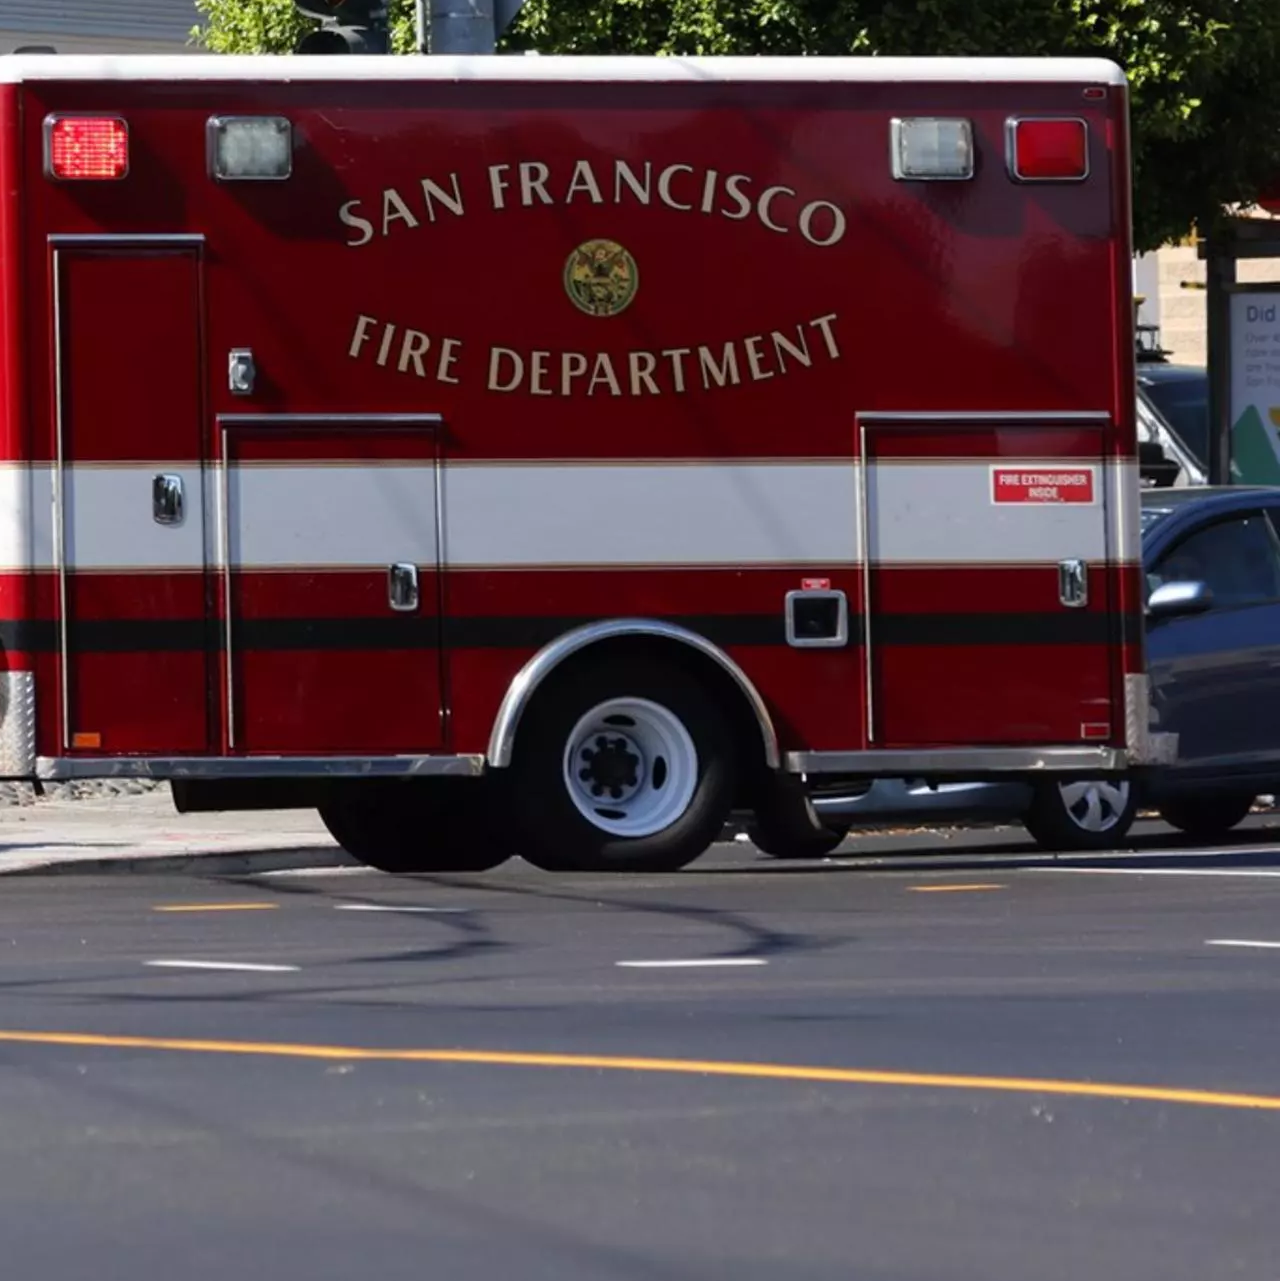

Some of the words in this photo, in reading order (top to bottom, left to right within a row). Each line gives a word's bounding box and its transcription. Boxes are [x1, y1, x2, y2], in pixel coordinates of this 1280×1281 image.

[339, 172, 465, 247] SAN
[488, 159, 848, 247] FRANCISCO
[1246, 304, 1276, 323] Did
[348, 314, 463, 385] FIRE
[487, 313, 842, 397] DEPARTMENT
[999, 474, 1021, 486] FIRE
